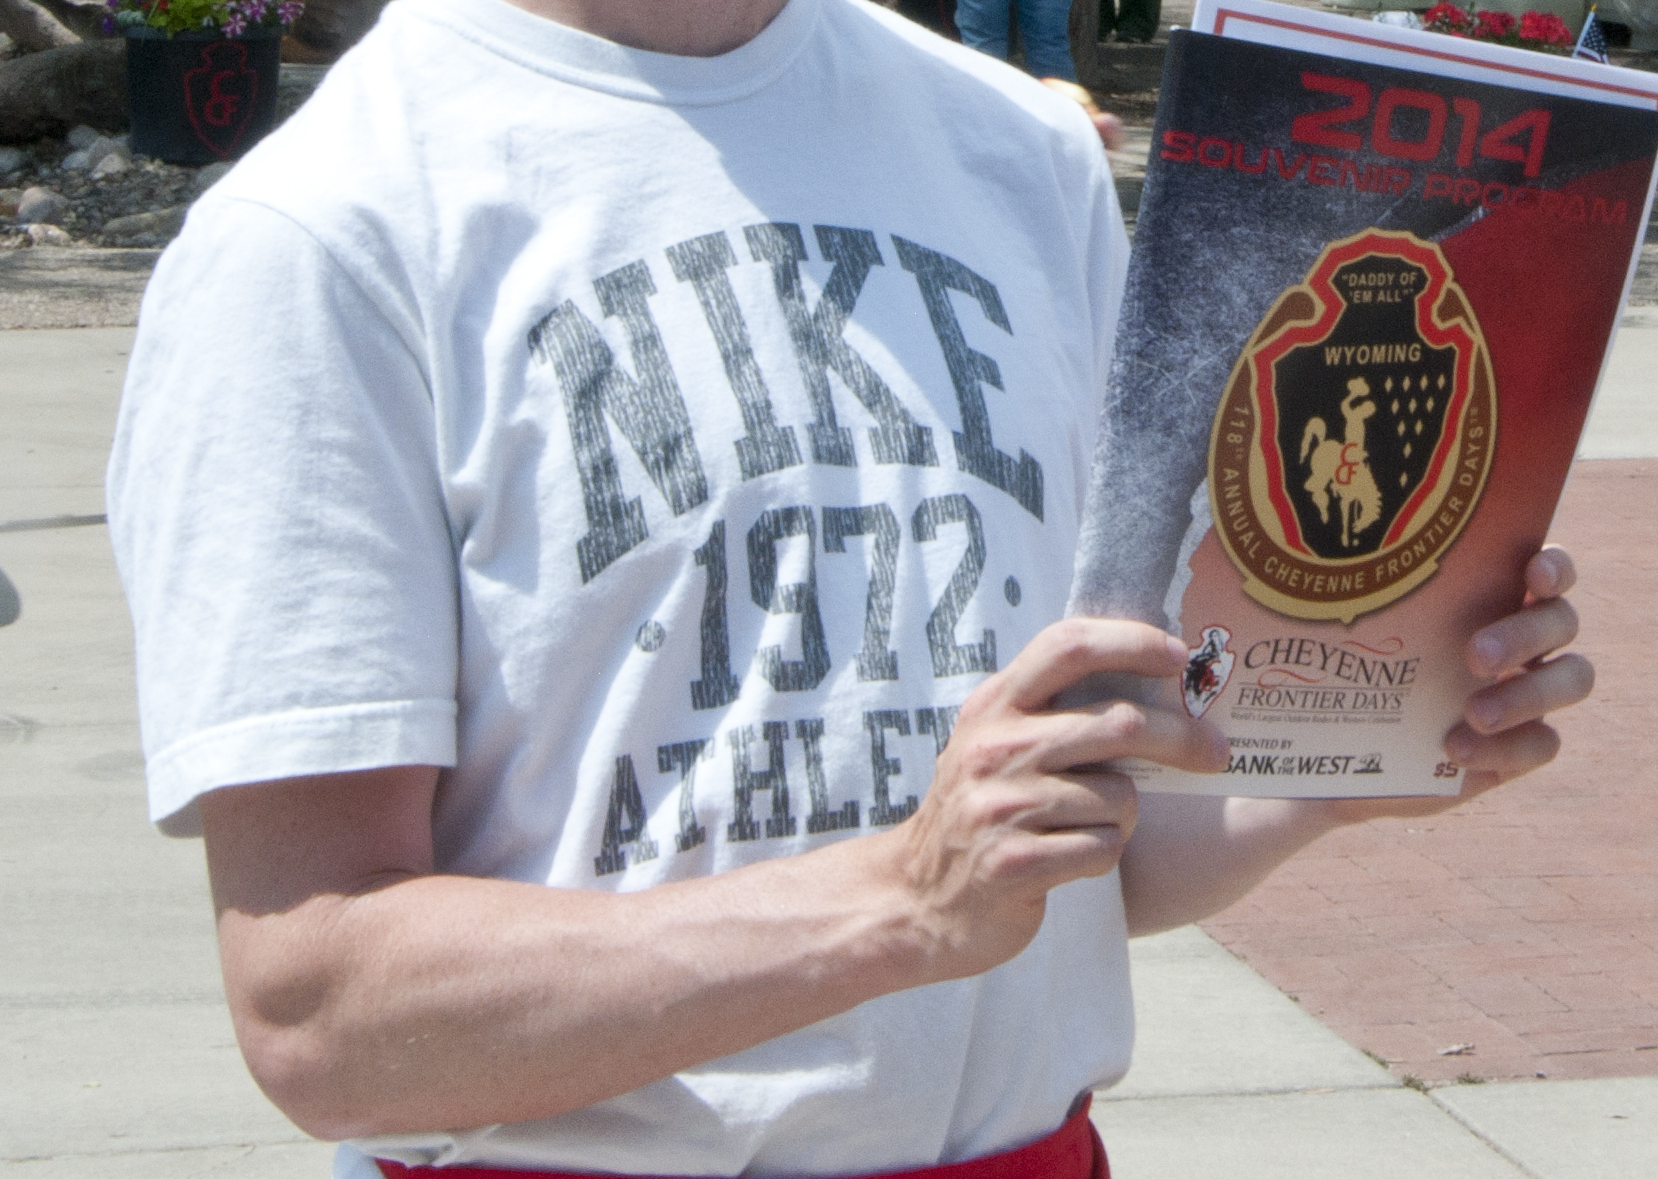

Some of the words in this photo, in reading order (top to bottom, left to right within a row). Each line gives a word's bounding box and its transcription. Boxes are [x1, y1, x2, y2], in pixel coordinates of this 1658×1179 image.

[1291, 72, 1552, 178] 2014
[1160, 129, 1412, 197] SOUVENIR
[1422, 173, 1628, 225] PROGRAM
[1400, 272, 1417, 285] OF
[1324, 343, 1421, 365] WYOMING
[527, 222, 1045, 585] NIKE
[1223, 468, 1261, 559] ANNUAL
[1264, 556, 1366, 594] CHEYENNE
[1375, 496, 1463, 582] FRONTIER
[690, 493, 998, 711] 1972
[1244, 637, 1421, 688] CHEYENNE
[1236, 687, 1346, 710] FRONTIER
[1280, 739, 1293, 750] BY
[1299, 755, 1356, 775] WEST
[1433, 761, 1459, 779] $5
